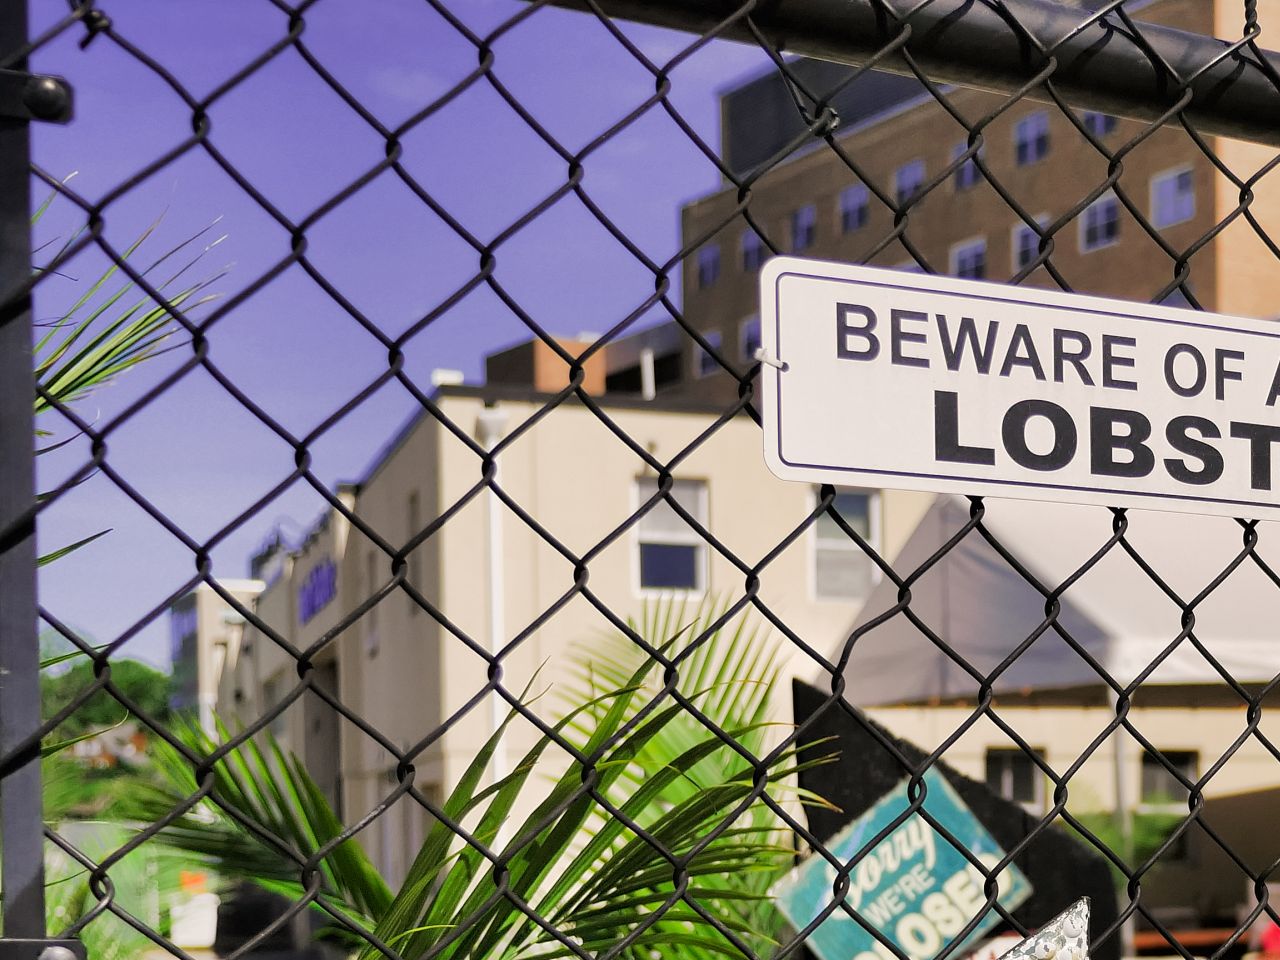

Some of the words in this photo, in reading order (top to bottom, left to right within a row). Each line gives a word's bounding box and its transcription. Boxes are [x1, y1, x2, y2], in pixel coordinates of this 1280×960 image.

[835, 301, 1138, 392] BEWARE
[1163, 342, 1245, 402] OF
[863, 863, 937, 929] WE'RE
